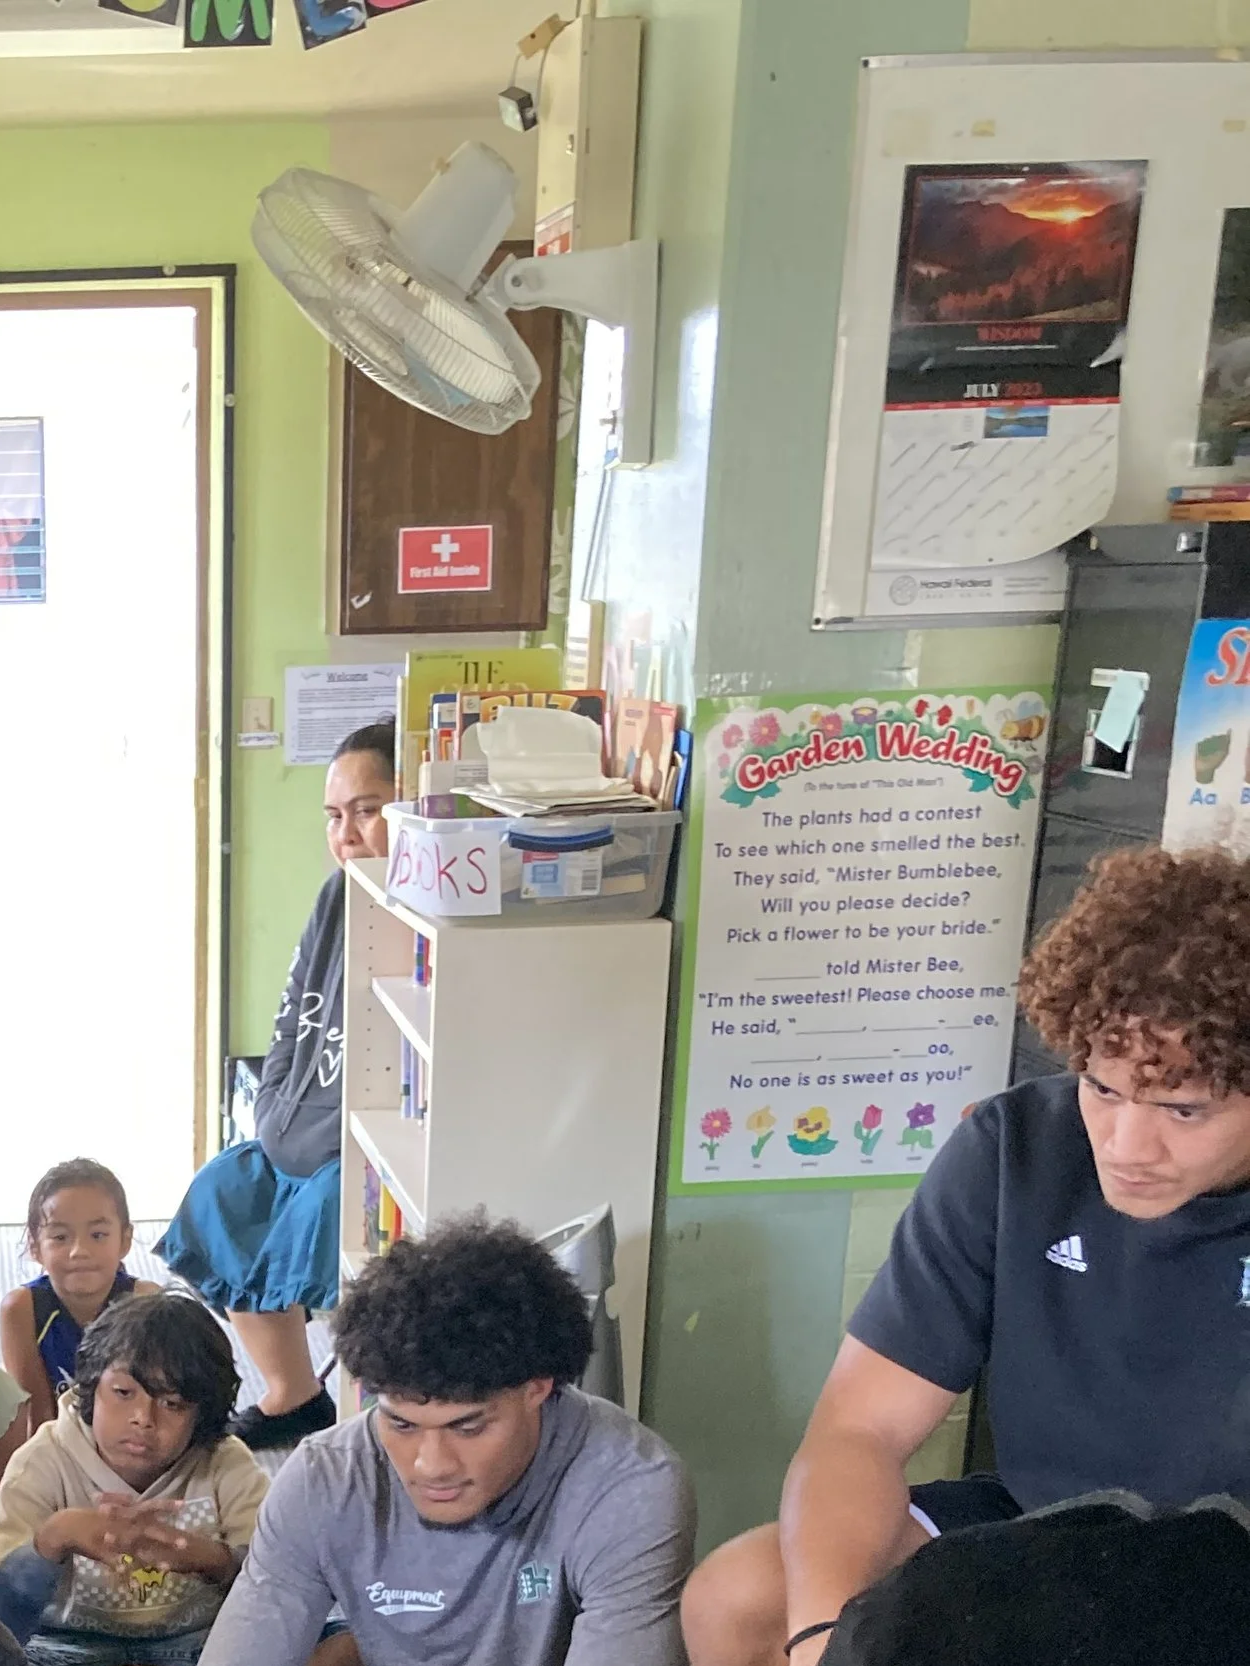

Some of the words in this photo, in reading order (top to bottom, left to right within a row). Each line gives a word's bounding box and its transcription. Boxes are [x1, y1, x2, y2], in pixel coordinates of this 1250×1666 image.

[963, 383, 999, 398] JULY
[409, 567, 431, 578] First
[326, 672, 368, 682] Welcome
[737, 729, 865, 793] Garden
[877, 721, 1025, 793] Wedding
[762, 812, 793, 827] The
[799, 810, 852, 830] plants
[860, 808, 892, 823] had
[899, 811, 909, 821] a
[915, 806, 982, 821] contest
[714, 843, 732, 858] To
[738, 845, 768, 857] see
[776, 840, 825, 855] which
[832, 842, 865, 853] one
[871, 834, 940, 852] smelled
[947, 834, 975, 848] the
[982, 833, 1026, 848] best.
[734, 871, 774, 888] They
[779, 868, 819, 884] said,
[898, 862, 1002, 879] Bumblebee,
[761, 898, 792, 913] Will
[799, 901, 830, 916] you
[837, 896, 894, 914] please
[902, 891, 970, 908] decide?
[727, 928, 760, 943] Pick
[768, 931, 777, 941] a
[784, 926, 839, 941] flower
[845, 926, 861, 938] to
[869, 924, 889, 937] be
[897, 925, 935, 940] your
[827, 960, 860, 975] told
[866, 959, 921, 974] Mister
[927, 957, 963, 972] Bee,
[740, 992, 765, 1006] the
[772, 988, 851, 1005] sweetest!
[857, 987, 910, 1002] Please
[917, 985, 974, 1000] choose
[712, 1020, 734, 1036] He
[741, 1019, 781, 1038] said,
[730, 1075, 753, 1088] No
[760, 1077, 791, 1087] one
[798, 1072, 810, 1086] is
[817, 1075, 836, 1085] as
[842, 1070, 894, 1084] sweet
[900, 1072, 918, 1082] as
[366, 1581, 445, 1604] Equipment
